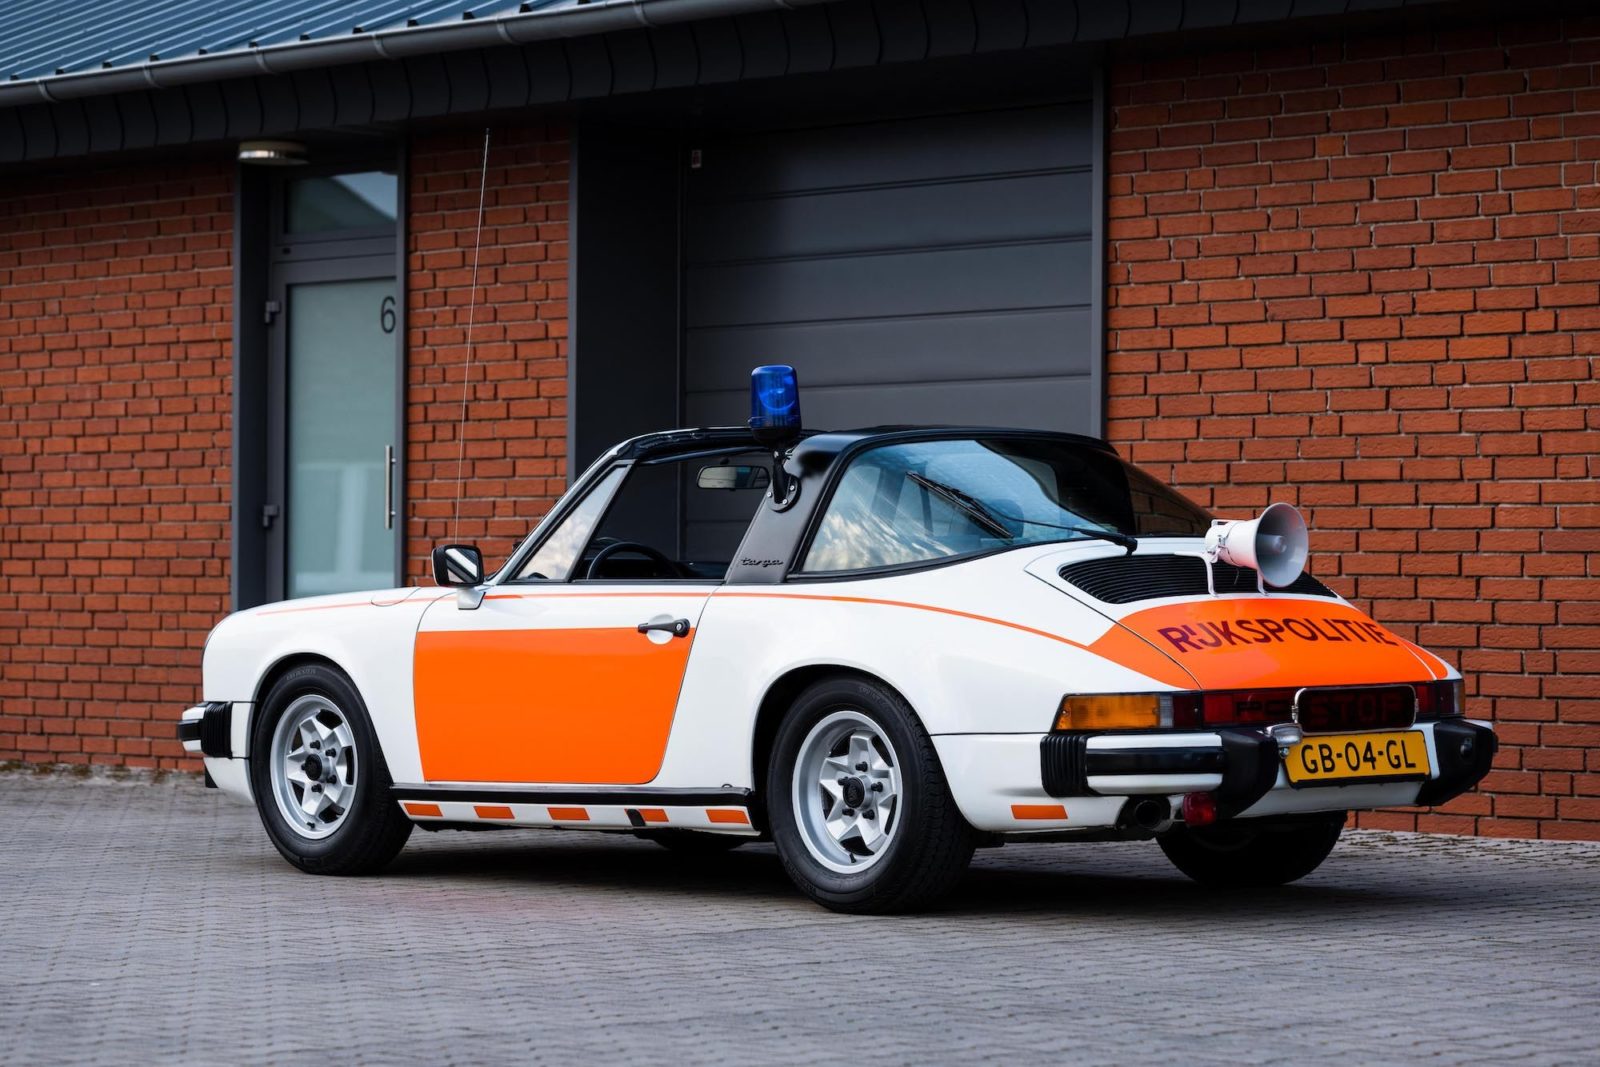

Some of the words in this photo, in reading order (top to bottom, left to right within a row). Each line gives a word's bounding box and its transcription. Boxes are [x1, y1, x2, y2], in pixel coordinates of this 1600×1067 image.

[380, 295, 396, 334] 6
[741, 557, 784, 568] targa
[1157, 617, 1400, 653] RIJKSPOLITIE
[1308, 691, 1402, 724] STOP
[1300, 739, 1417, 774] GB-04-GL
